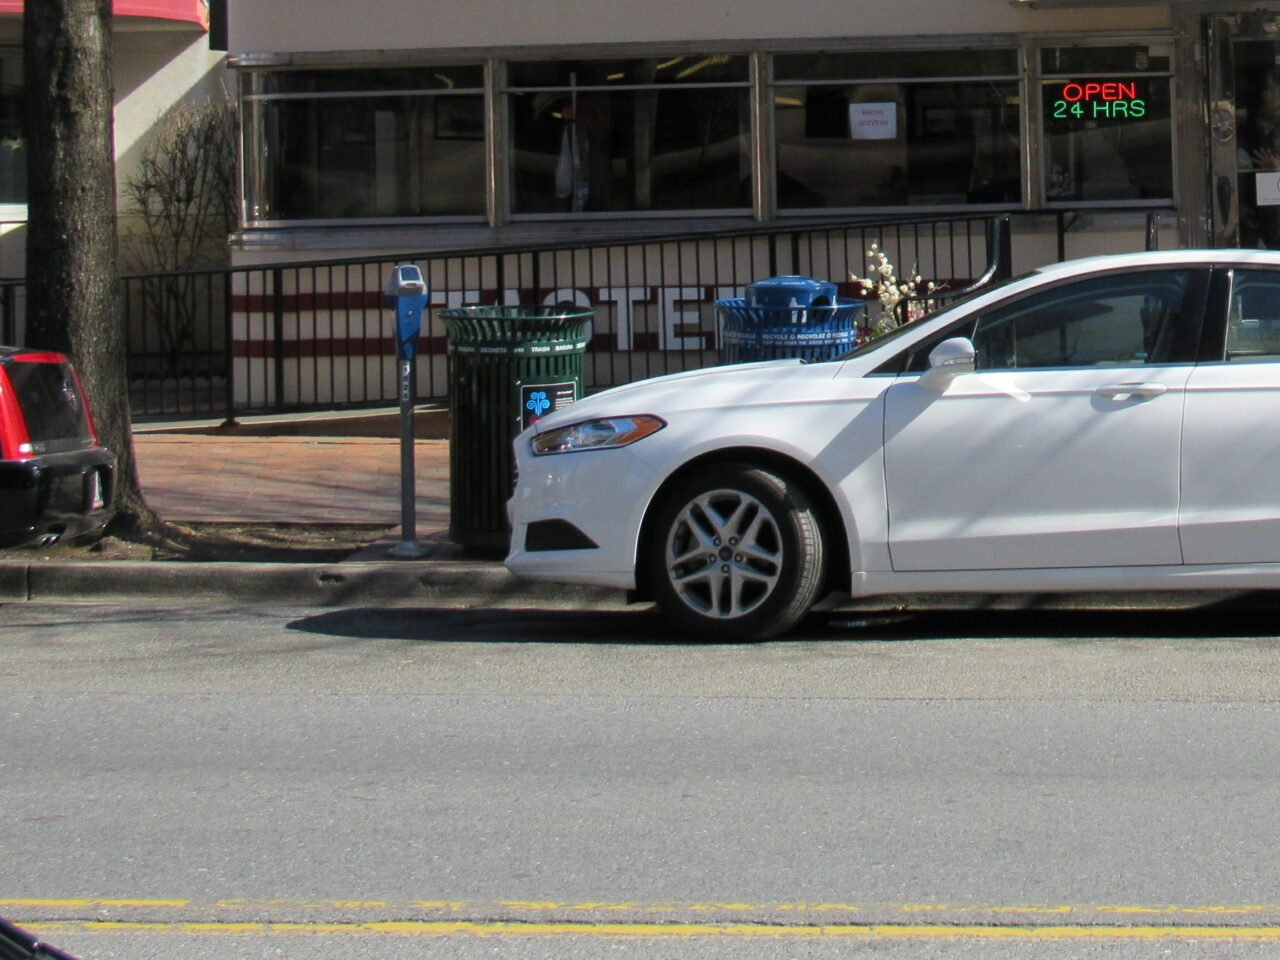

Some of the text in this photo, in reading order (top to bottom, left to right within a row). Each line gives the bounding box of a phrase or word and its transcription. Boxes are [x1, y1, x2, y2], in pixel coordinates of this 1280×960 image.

[1063, 82, 1135, 101] OPEN
[1053, 100, 1145, 118] 24 HRS
